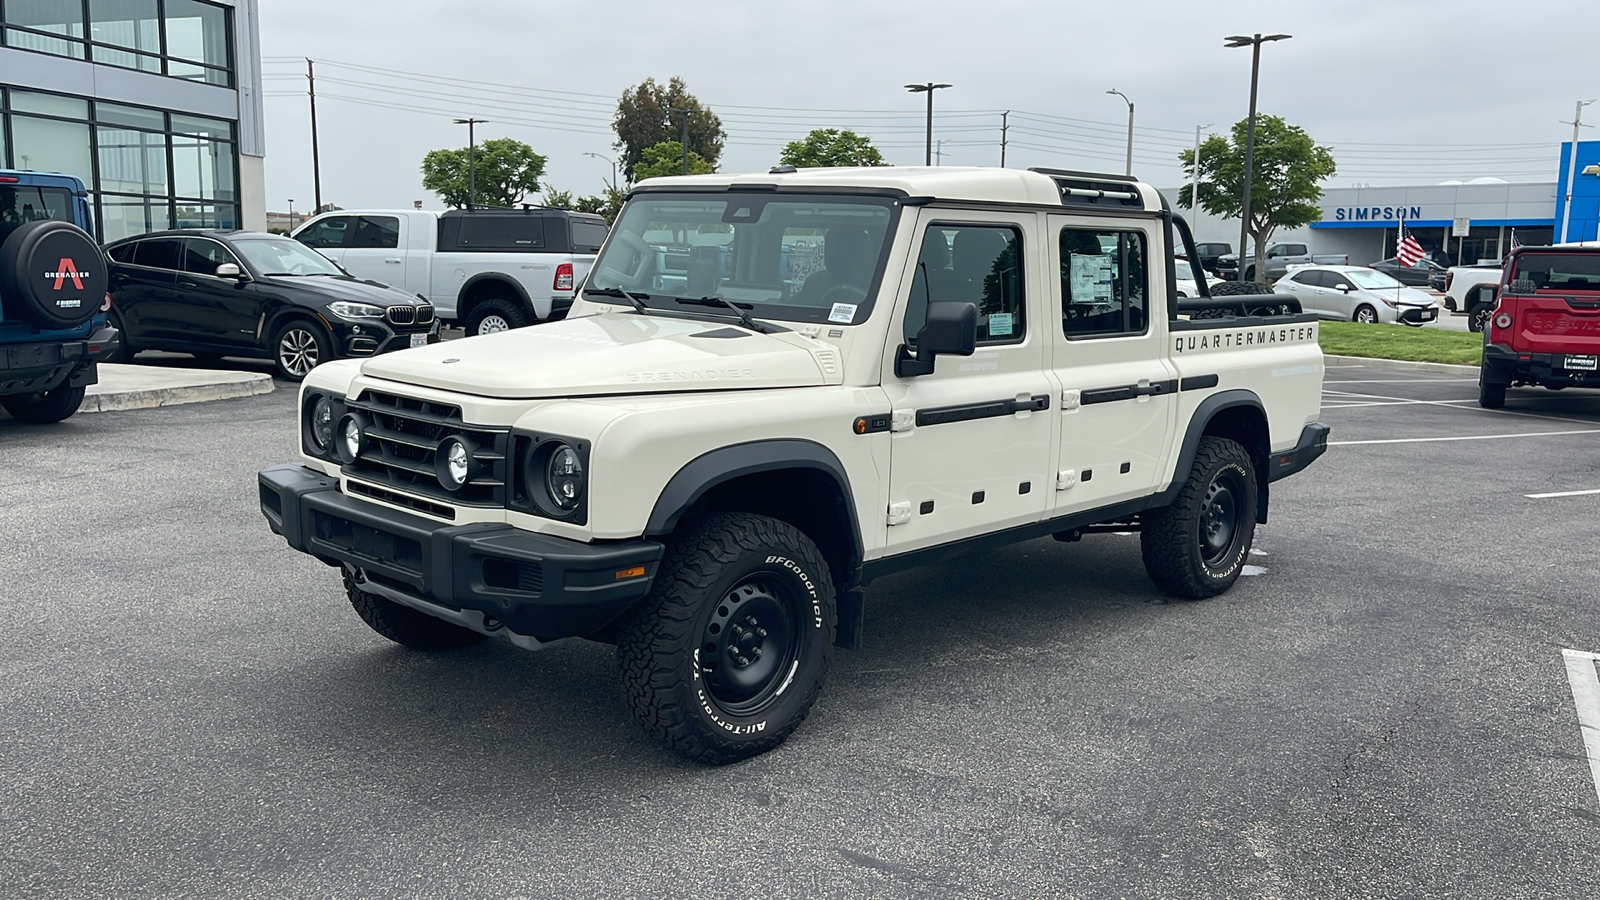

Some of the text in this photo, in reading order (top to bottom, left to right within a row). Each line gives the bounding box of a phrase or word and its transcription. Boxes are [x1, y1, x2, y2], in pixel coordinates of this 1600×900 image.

[1335, 206, 1421, 220] SIMPSON
[44, 271, 90, 279] GRENADIER
[1175, 327, 1314, 353] QUARTERMASTER
[626, 368, 756, 383] GRENADIER
[765, 555, 823, 628] BFGoodrich
[692, 648, 767, 735] All-Terrain T/A
